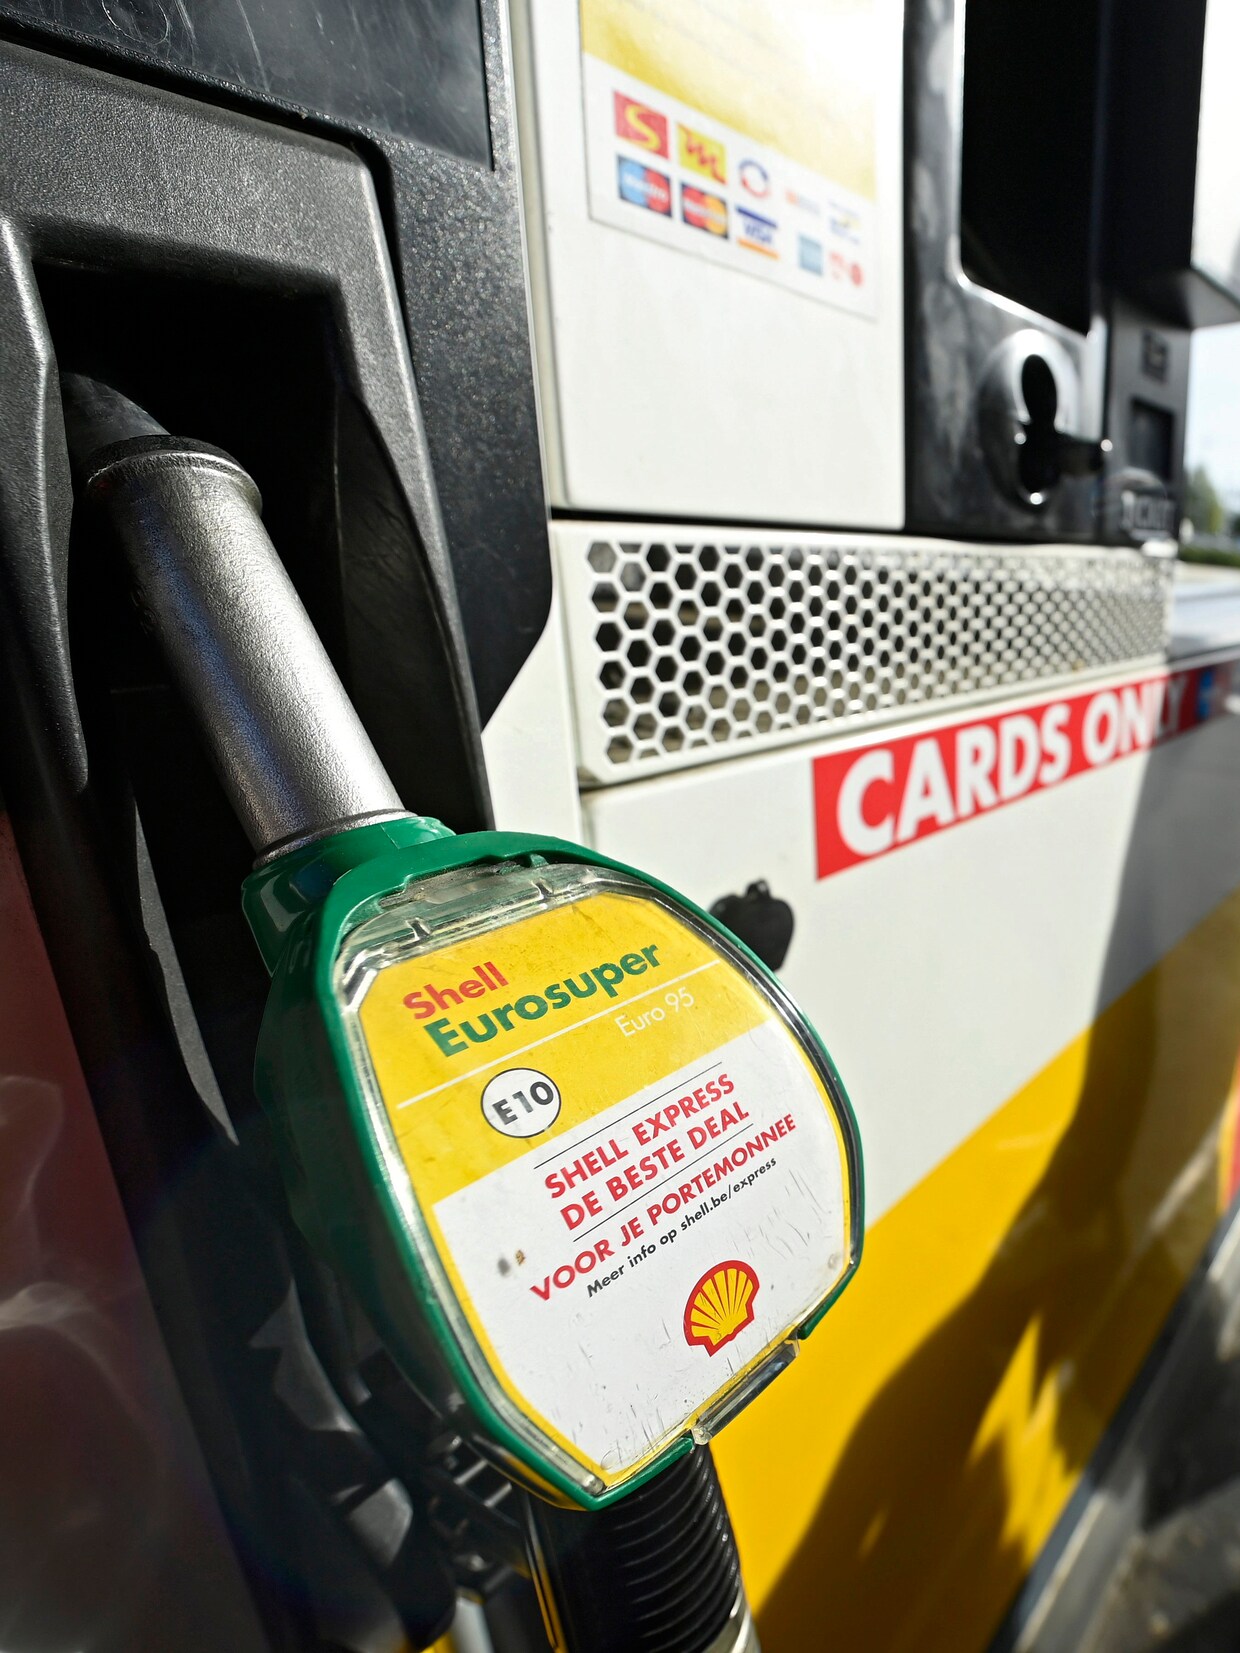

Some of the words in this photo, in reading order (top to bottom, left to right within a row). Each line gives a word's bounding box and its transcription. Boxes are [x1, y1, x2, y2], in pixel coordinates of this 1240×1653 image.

[837, 704, 1072, 856] CARDS
[1081, 676, 1184, 764] ONLY
[403, 961, 508, 1019] Shell
[424, 943, 661, 1057] Eurosuper
[614, 1003, 666, 1037] Euro
[664, 986, 694, 1012] 95
[492, 1081, 555, 1126] E10
[544, 1139, 629, 1199] SHELL
[632, 1073, 735, 1146] EXPRESS
[560, 1191, 603, 1230] DE
[605, 1139, 685, 1200] BESTE
[686, 1102, 749, 1156] DEAL
[530, 1239, 615, 1301] VOOR
[619, 1216, 645, 1247] JE
[646, 1113, 797, 1227] PORTEMONNEE
[586, 1264, 626, 1299] Meer
[627, 1243, 656, 1269] info
[659, 1227, 679, 1249] op
[680, 1156, 777, 1231] shell.be/express
